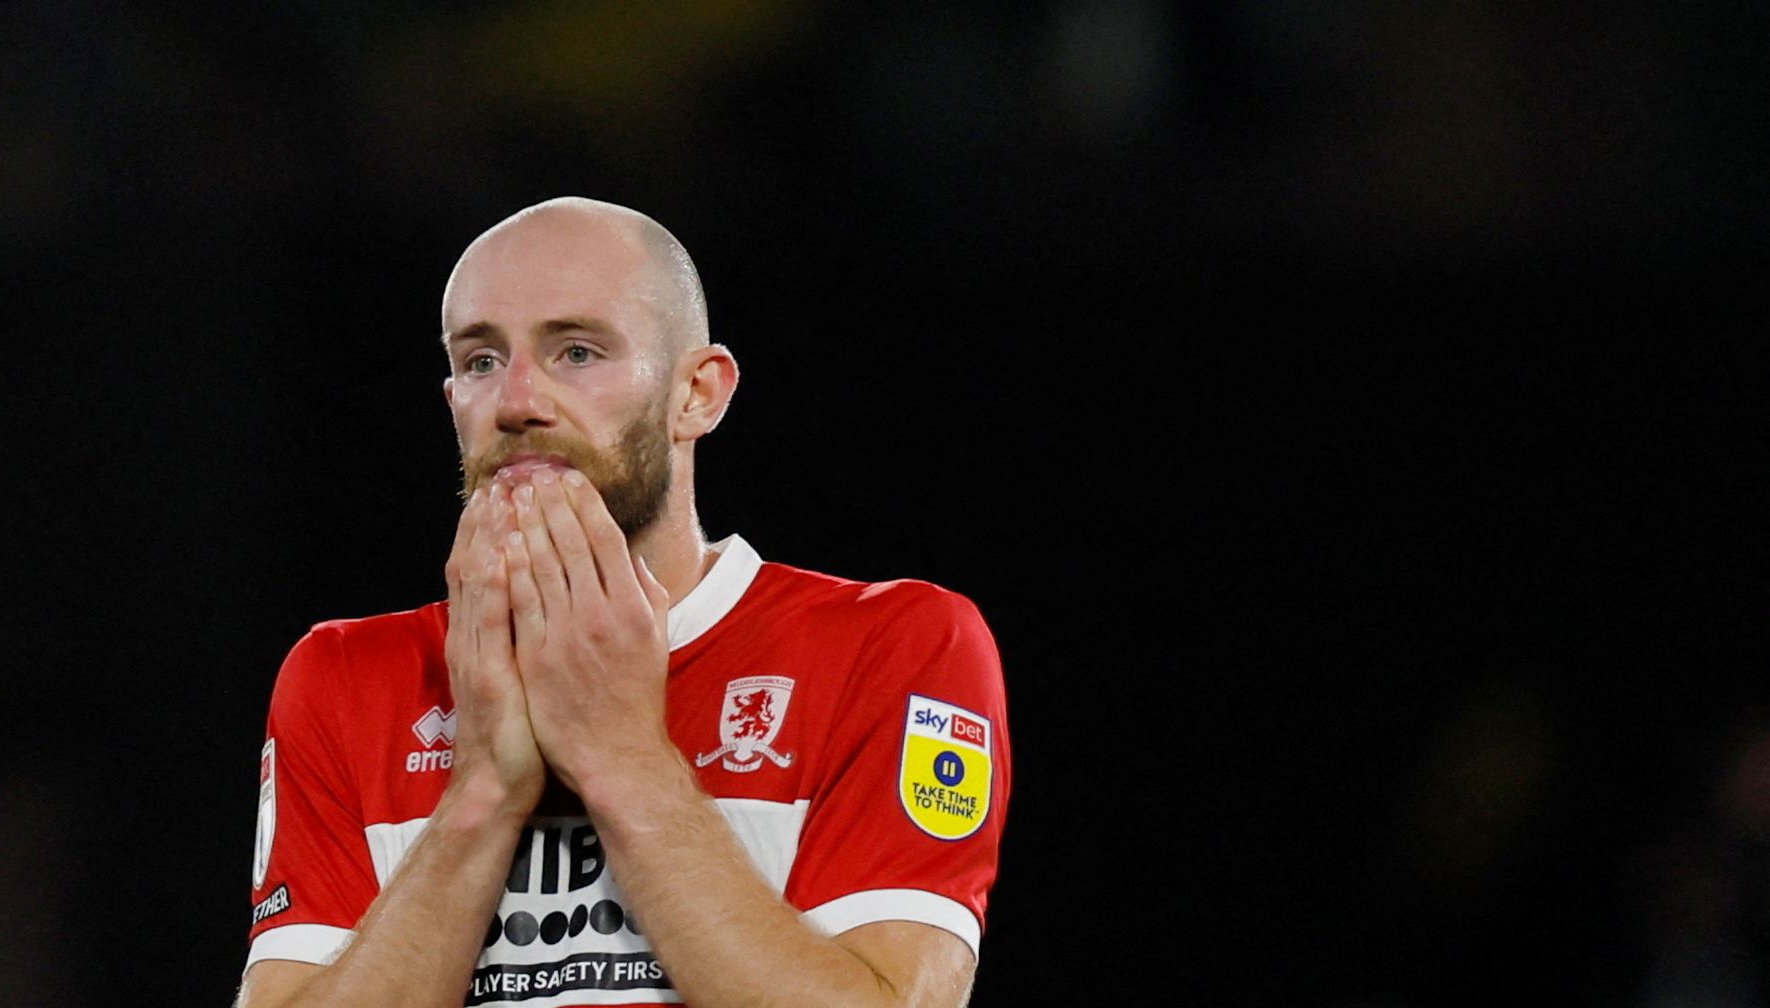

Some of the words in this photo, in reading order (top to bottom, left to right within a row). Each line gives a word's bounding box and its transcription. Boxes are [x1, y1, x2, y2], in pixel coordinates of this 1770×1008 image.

[914, 708, 949, 733] sky
[954, 716, 983, 743] bet
[405, 749, 454, 773] erre
[913, 782, 945, 800] TAKE
[948, 790, 978, 808] TIME
[915, 795, 933, 809] TO
[935, 800, 974, 819] THINK
[470, 972, 530, 997] LAYER
[533, 961, 607, 989] SAFETY
[614, 960, 664, 982] FIRS
